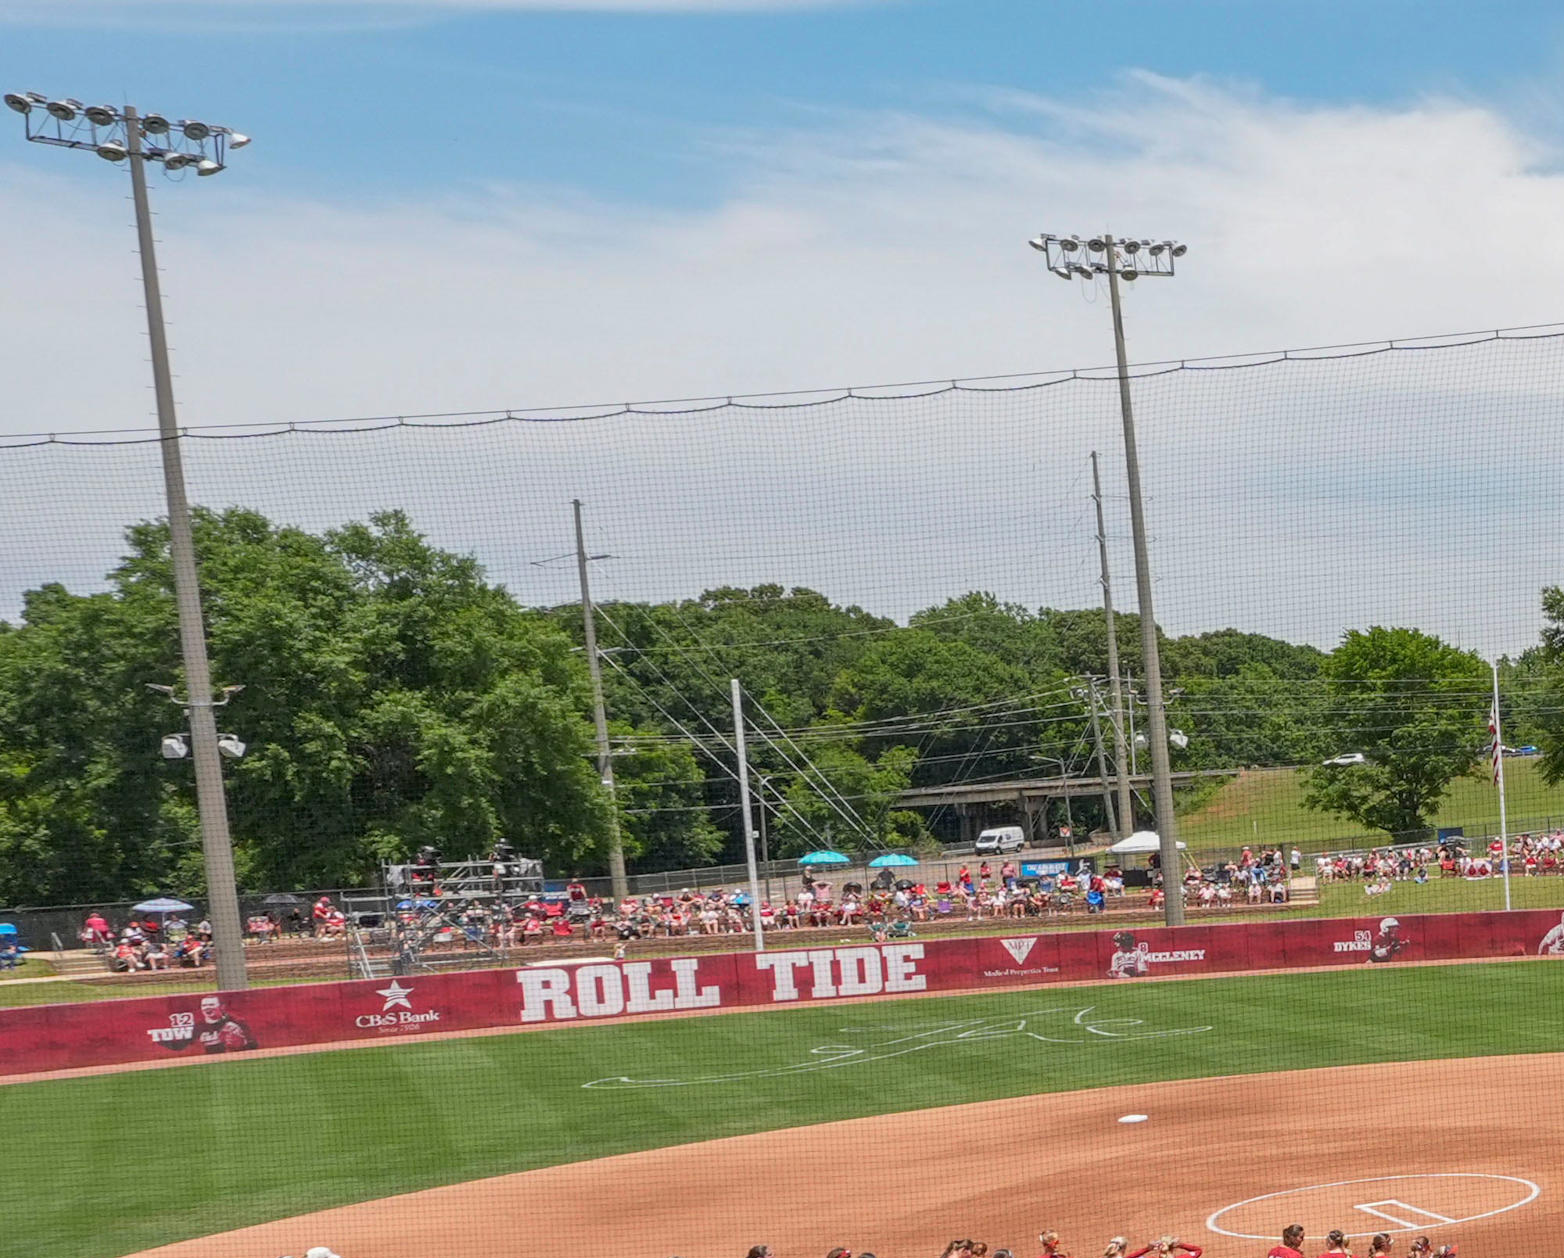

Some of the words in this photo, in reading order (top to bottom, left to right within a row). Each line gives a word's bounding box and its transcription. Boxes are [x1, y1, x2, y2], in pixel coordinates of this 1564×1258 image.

[1334, 941, 1371, 952] DYKES
[1141, 950, 1205, 963] MCCLENEY
[516, 958, 721, 1023] ROLL
[755, 943, 927, 1002] TIDE
[168, 1012, 194, 1027] 12
[399, 1010, 440, 1024] Bank
[147, 1026, 194, 1042] TOW
